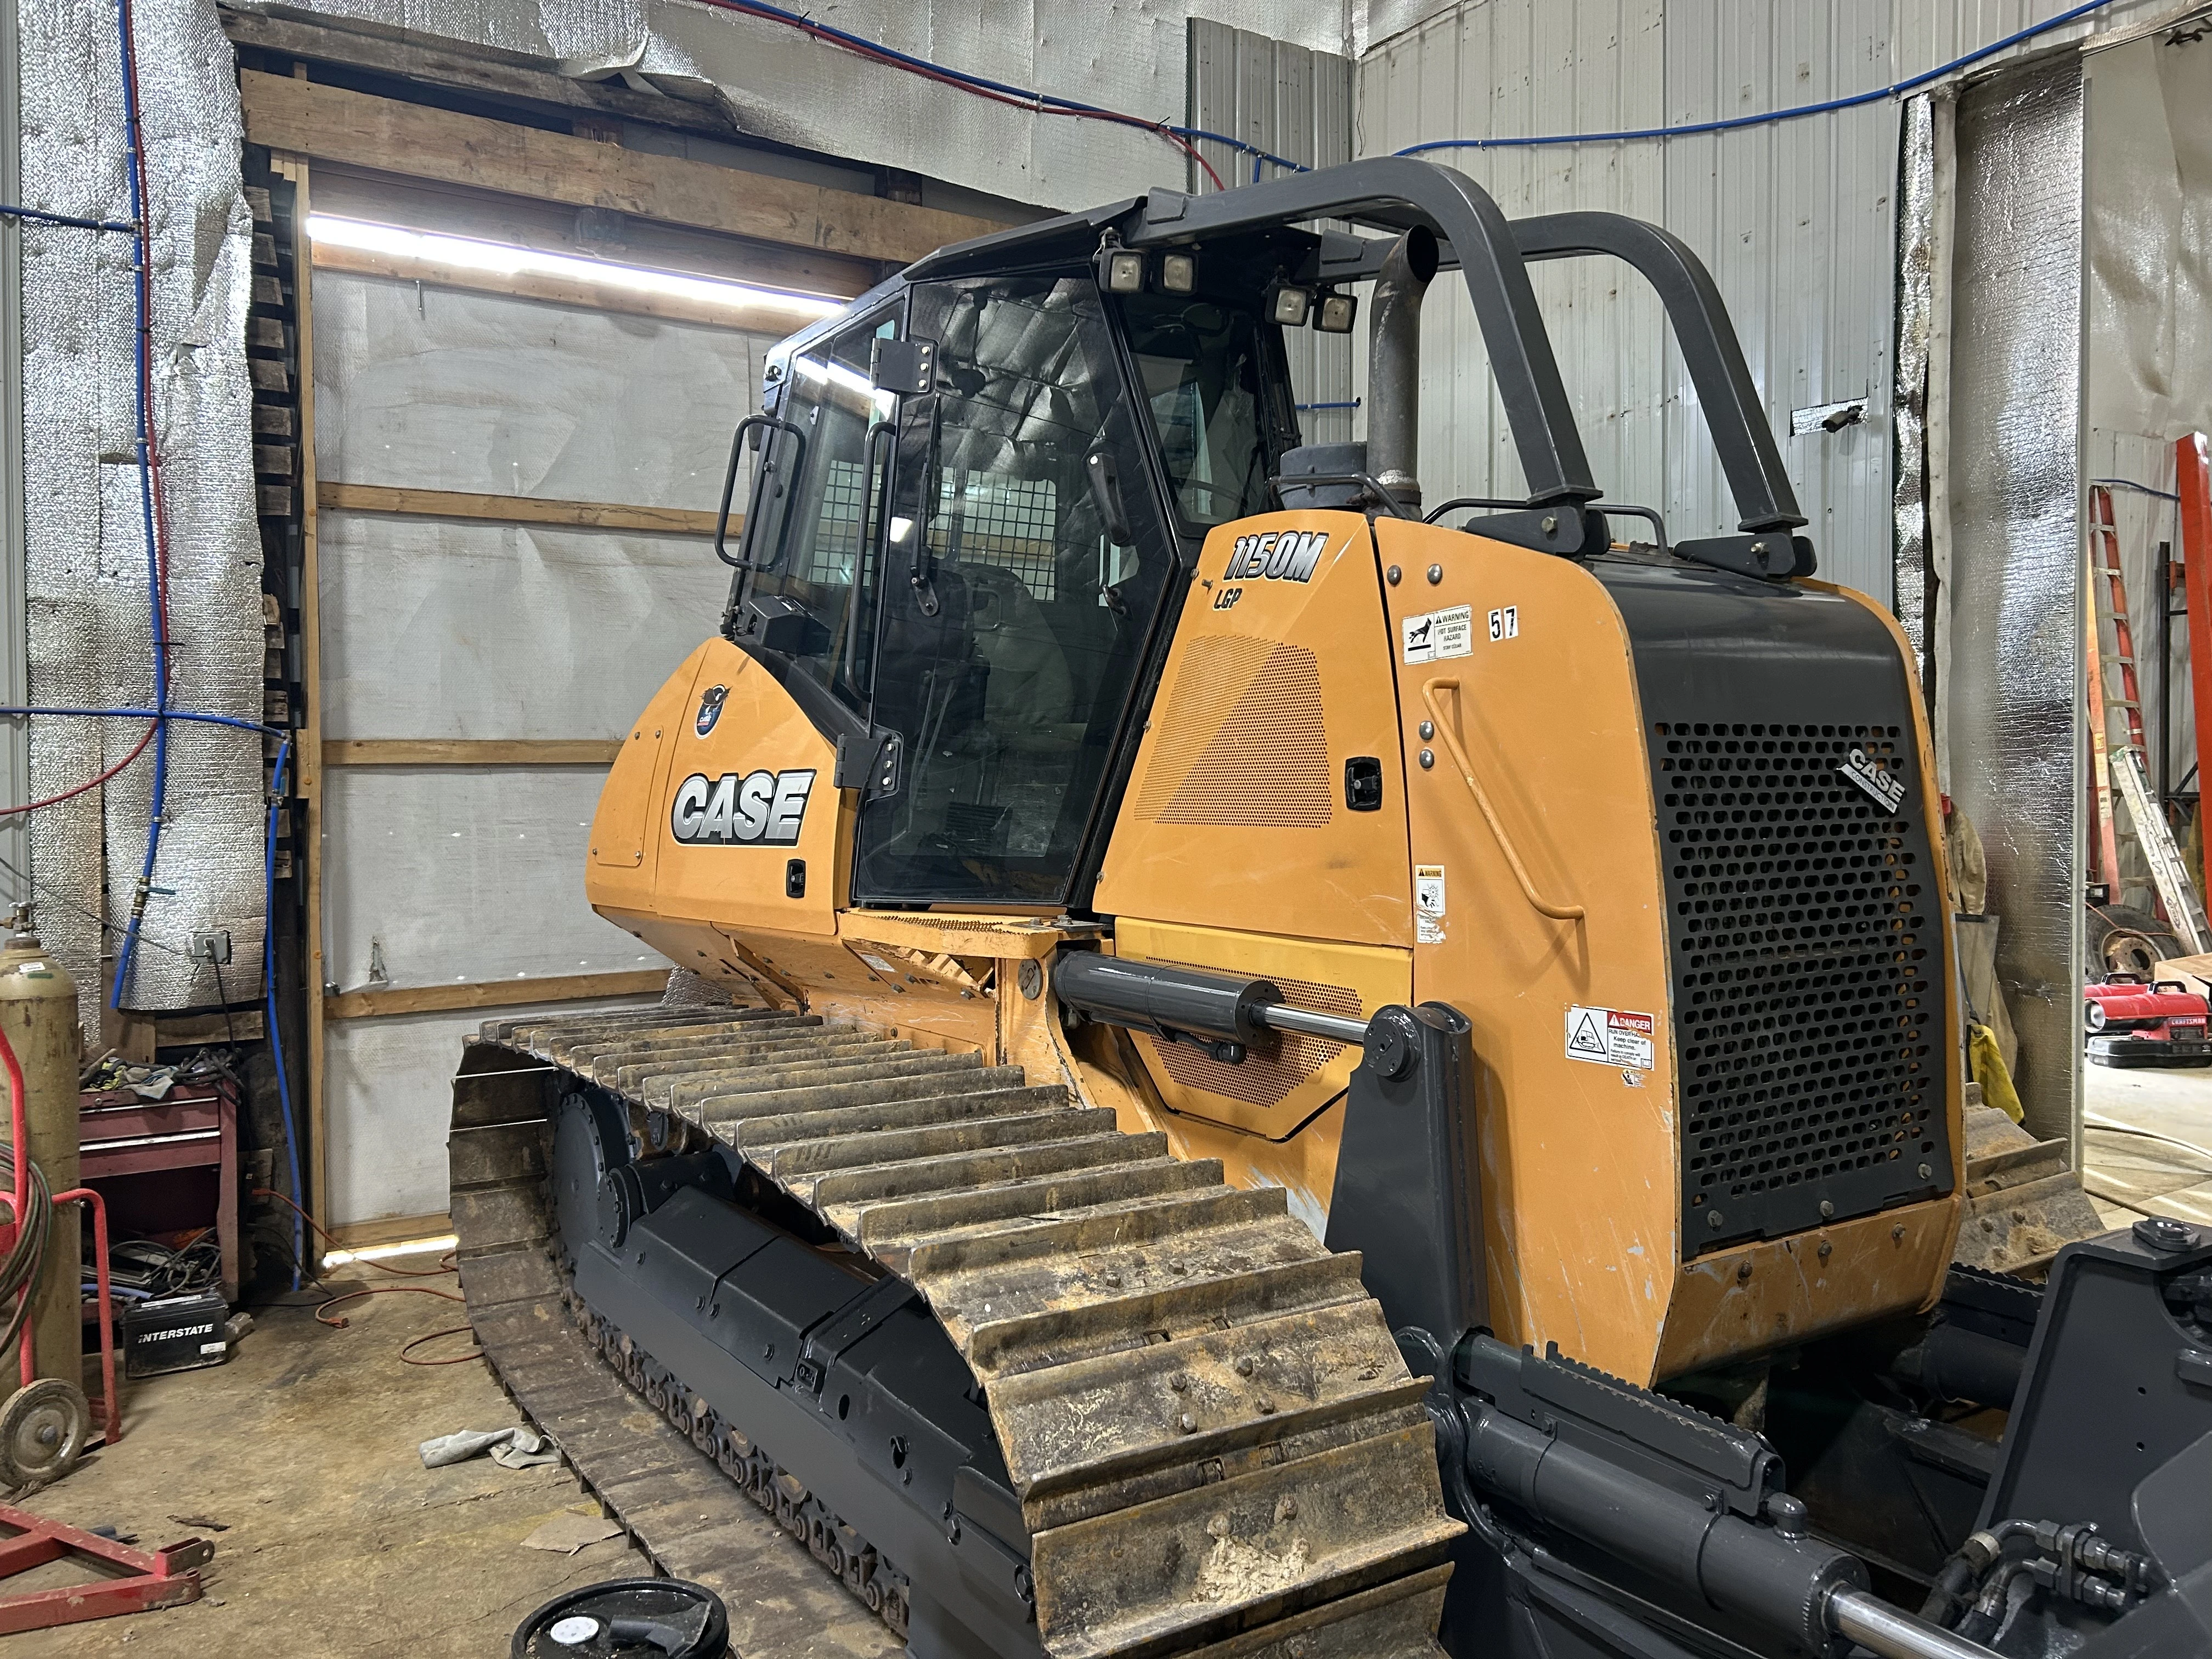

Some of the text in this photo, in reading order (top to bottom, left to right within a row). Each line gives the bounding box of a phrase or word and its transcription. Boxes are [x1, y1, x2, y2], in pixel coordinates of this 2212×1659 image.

[1223, 531, 1329, 583] 1150M
[1214, 588, 1243, 610] LGP
[1442, 611, 1469, 623] WARNING
[1443, 633, 1461, 641] HAZARD
[1447, 624, 1467, 633] SURFACE
[1849, 749, 1905, 803] CASE
[1850, 771, 1895, 811] CONSTRUCTION
[672, 769, 816, 842] CASE
[1620, 1018, 1651, 1030] DANGER
[138, 1323, 214, 1344] INTERSTATE
